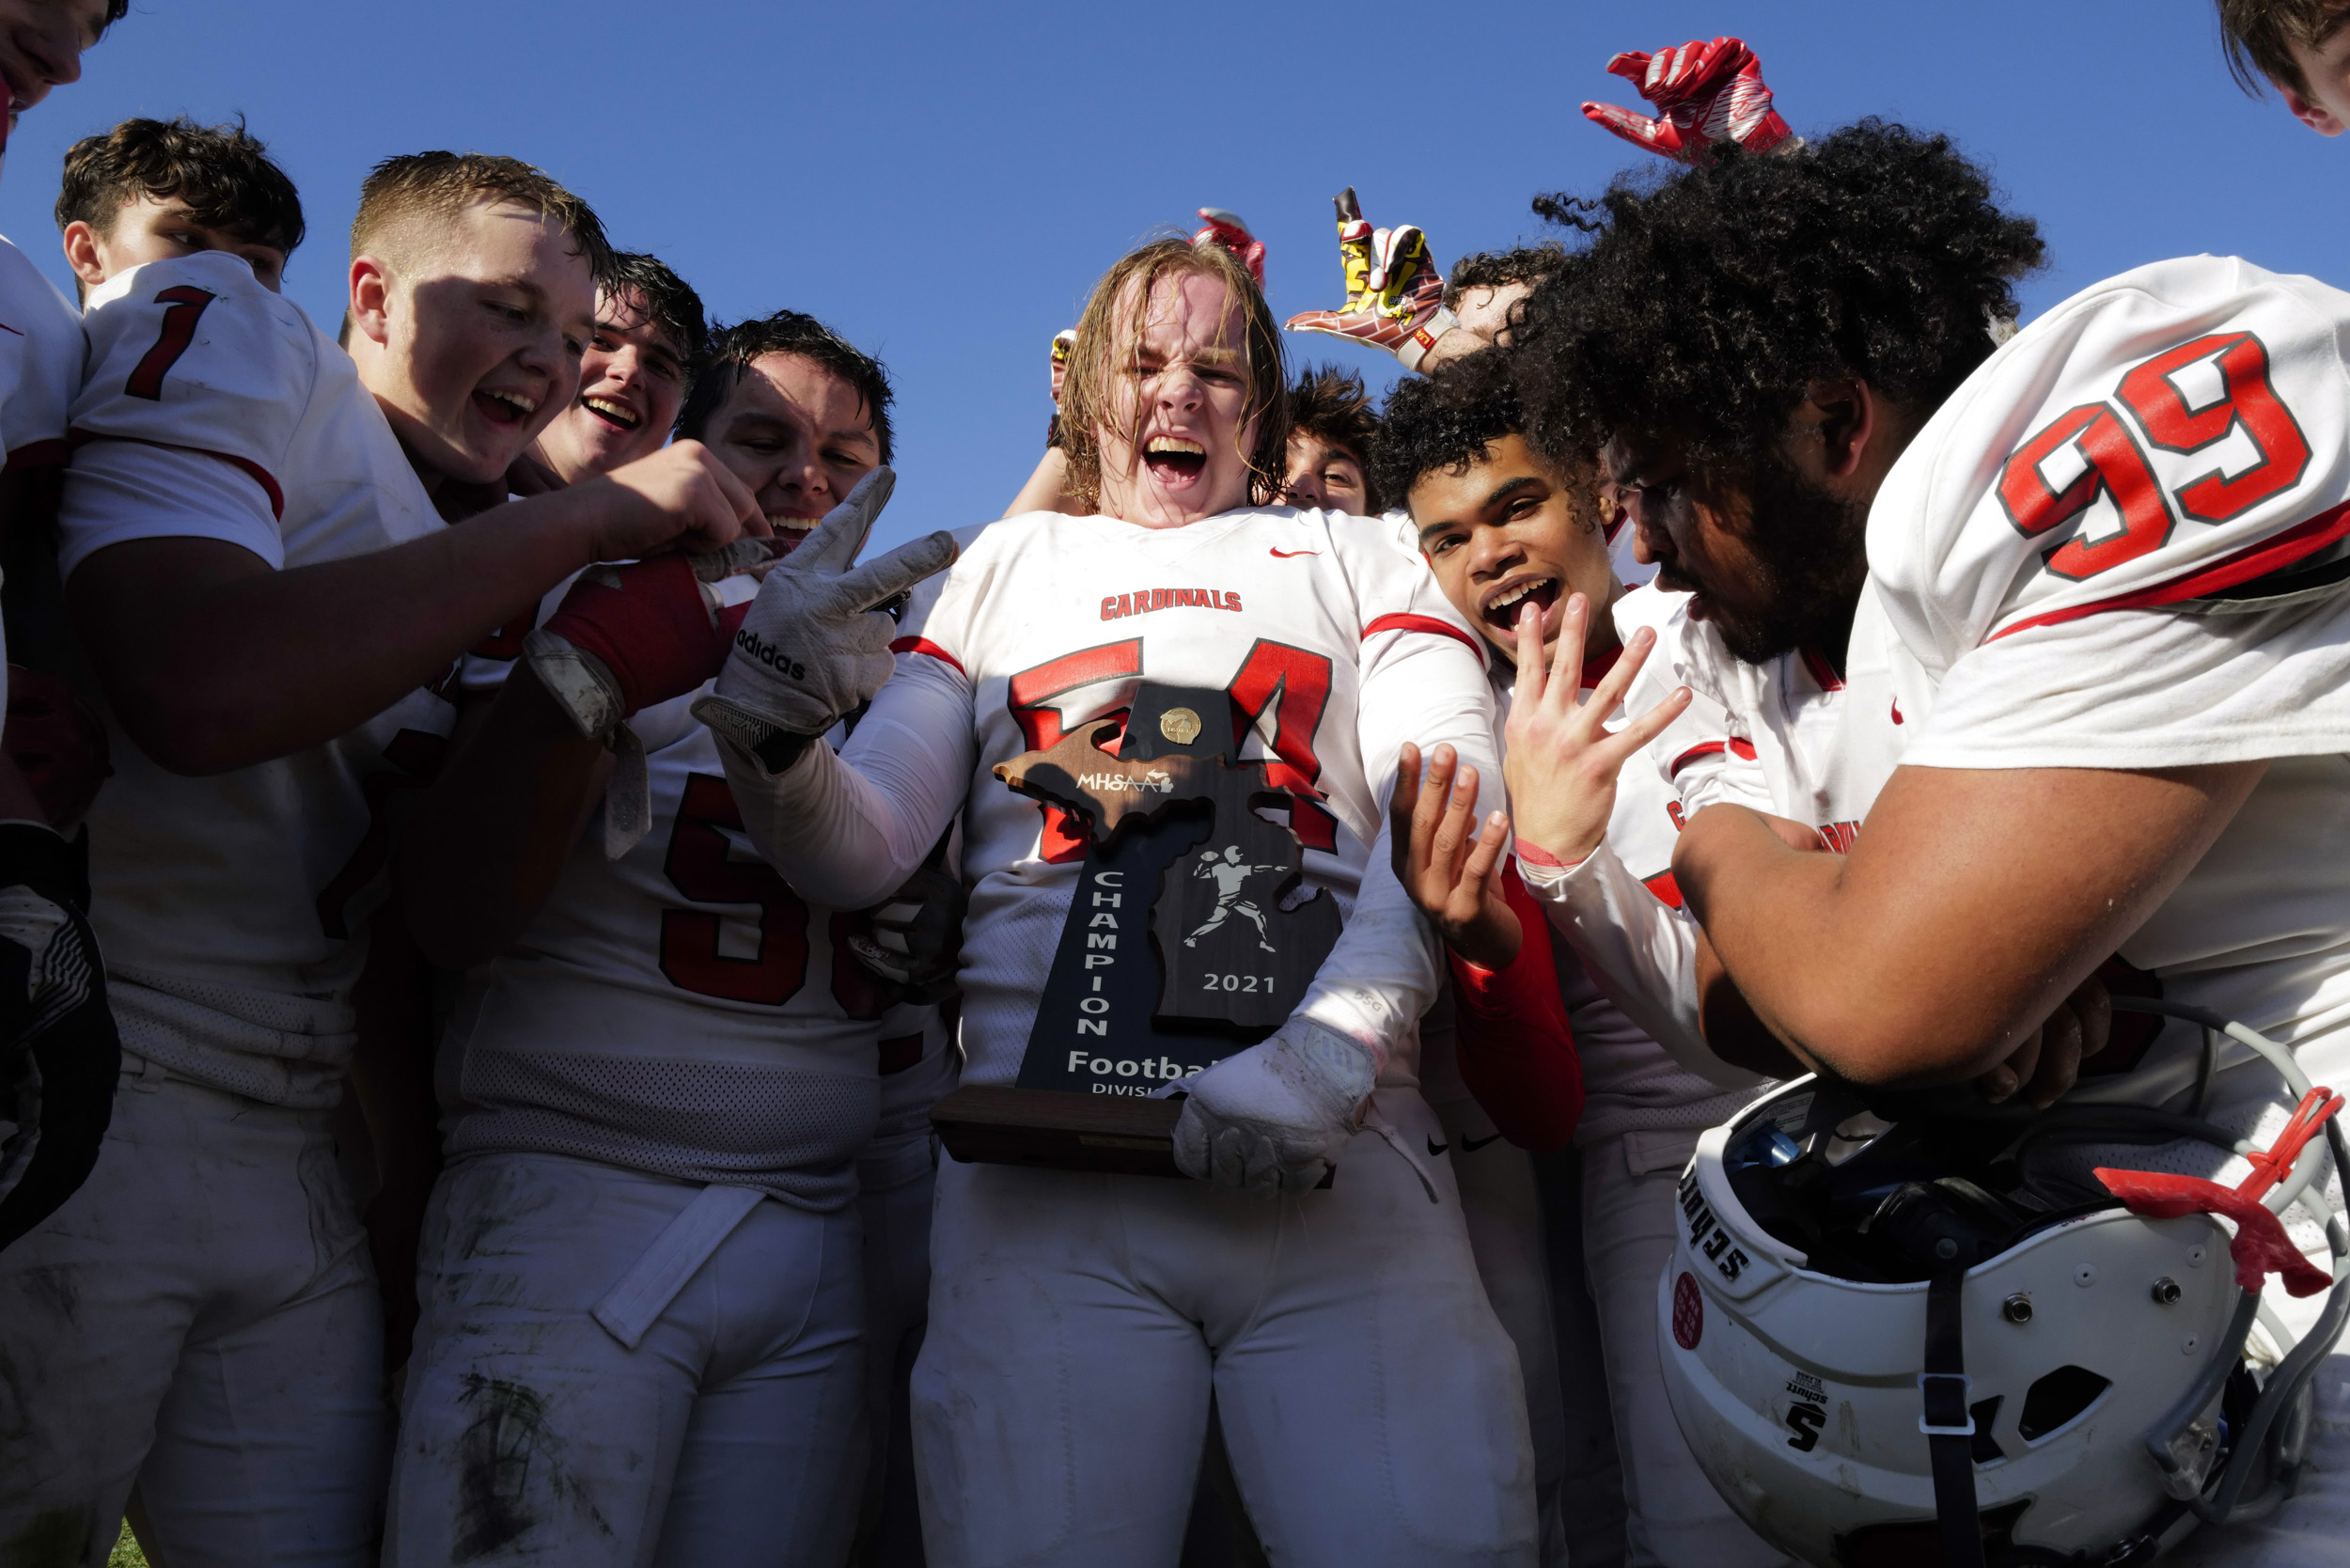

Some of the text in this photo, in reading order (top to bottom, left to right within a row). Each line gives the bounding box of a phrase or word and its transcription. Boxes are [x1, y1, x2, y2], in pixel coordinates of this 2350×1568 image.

[1995, 330, 2313, 582] 99
[1100, 588, 1243, 621] CARDINALS
[736, 629, 806, 681] adidas
[1075, 772, 1160, 792] MHSAA
[1077, 871, 1124, 1036] CHAMPION
[1202, 974, 1275, 994] 2021
[1068, 1050, 1221, 1080] Footba
[1092, 1083, 1161, 1097] DIVISI
[1786, 1383, 1828, 1404] schutt
